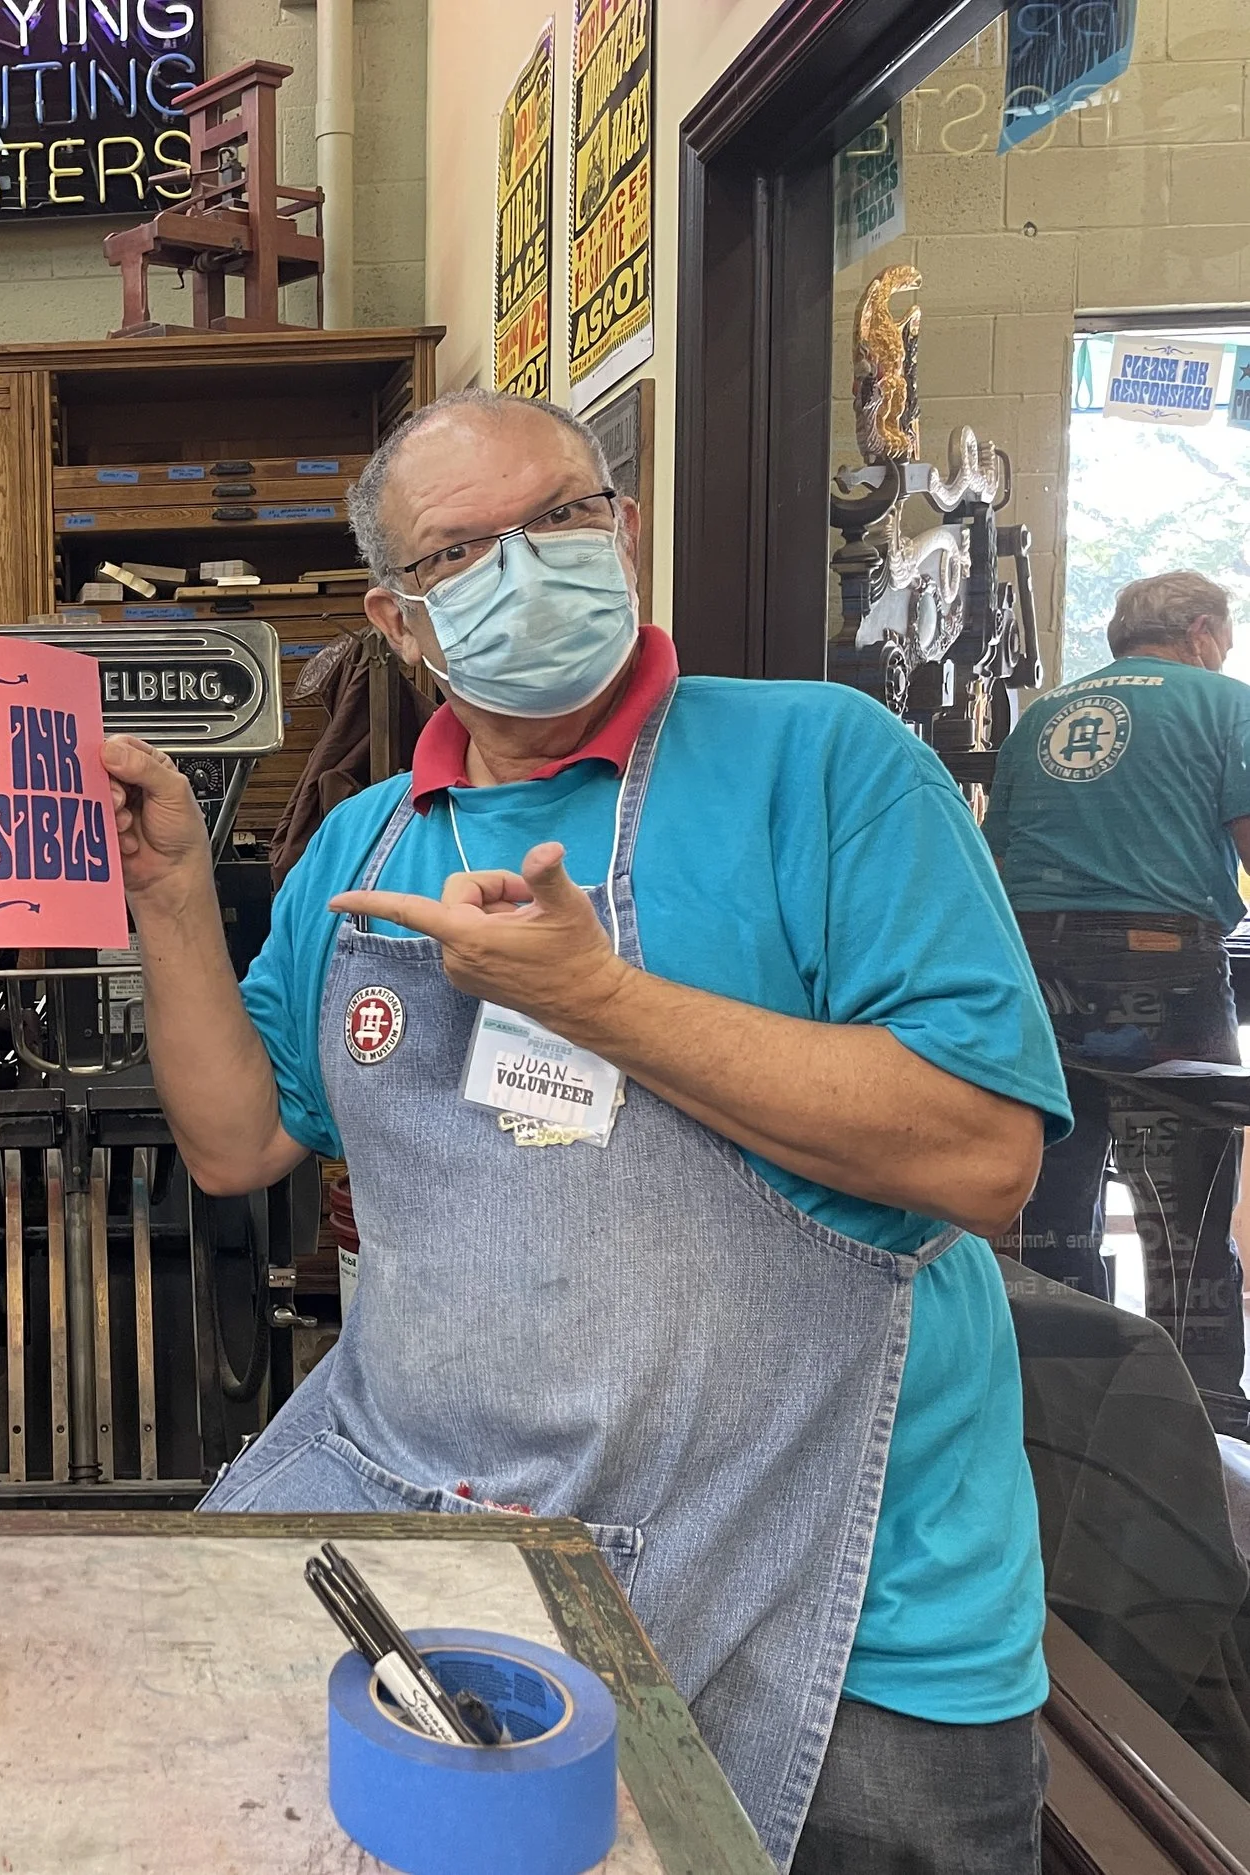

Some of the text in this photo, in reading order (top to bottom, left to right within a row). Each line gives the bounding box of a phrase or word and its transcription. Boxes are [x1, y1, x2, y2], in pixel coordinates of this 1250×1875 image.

[610, 70, 649, 182] RACES
[502, 147, 547, 276] MIDGET
[600, 163, 647, 238] RACES
[632, 192, 647, 222] EACH
[857, 192, 895, 240] ROLL
[606, 216, 625, 275] NITE
[630, 219, 648, 251] MONTH
[503, 229, 545, 314] RACE
[573, 248, 647, 357] ASCOT
[1121, 354, 1209, 385] PLEASE INK
[1110, 378, 1213, 410] RESPONSIBLY
[1052, 698, 1127, 726] INTERNATIONAL
[10, 705, 83, 795] INK
[350, 988, 401, 1018] INTERNATIONAL
[370, 1029, 399, 1060] MUSEUM
[497, 1068, 594, 1106] VOLUNTEER
[513, 1054, 568, 1082] JUAN
